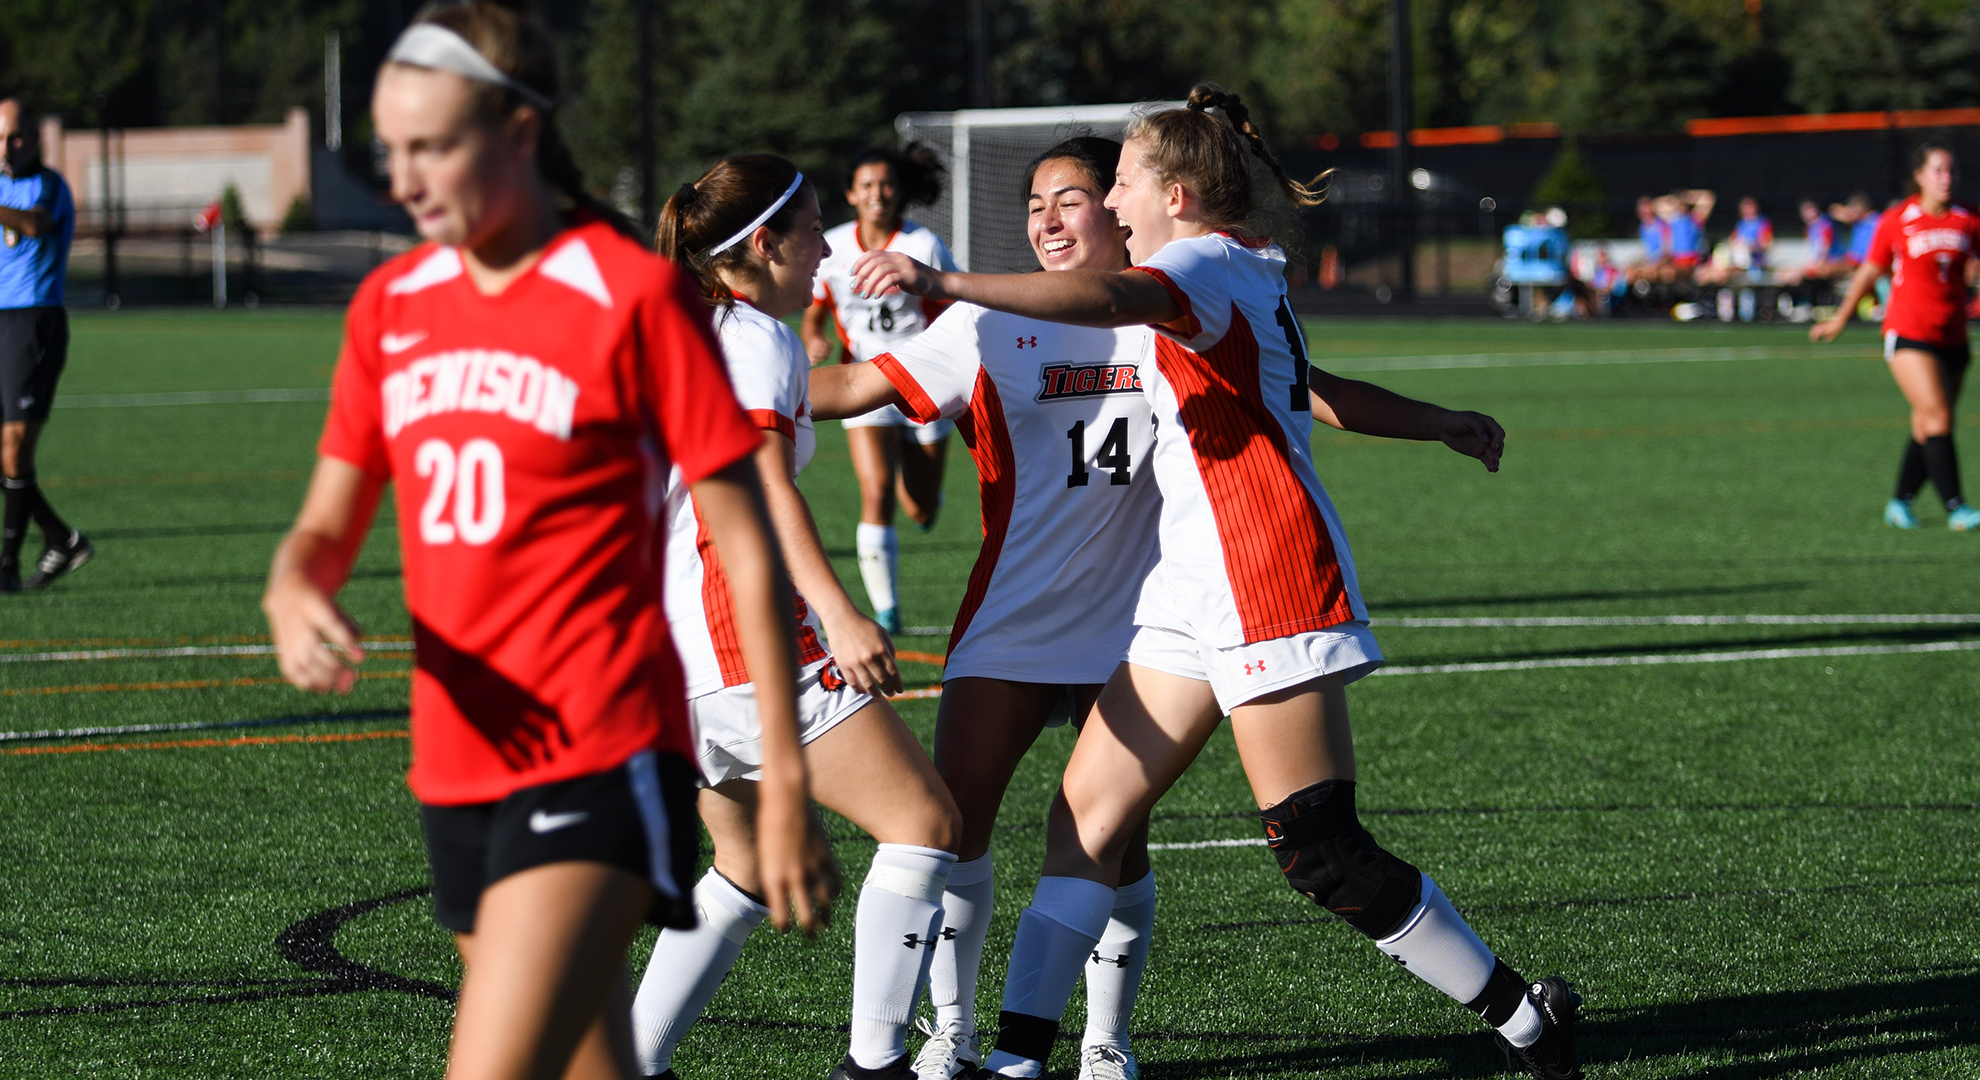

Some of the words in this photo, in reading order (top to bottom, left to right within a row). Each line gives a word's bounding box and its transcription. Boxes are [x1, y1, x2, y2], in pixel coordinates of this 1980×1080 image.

[868, 302, 894, 332] 18
[382, 348, 580, 441] DENISON
[415, 438, 505, 545] 20
[1066, 416, 1131, 488] 14
